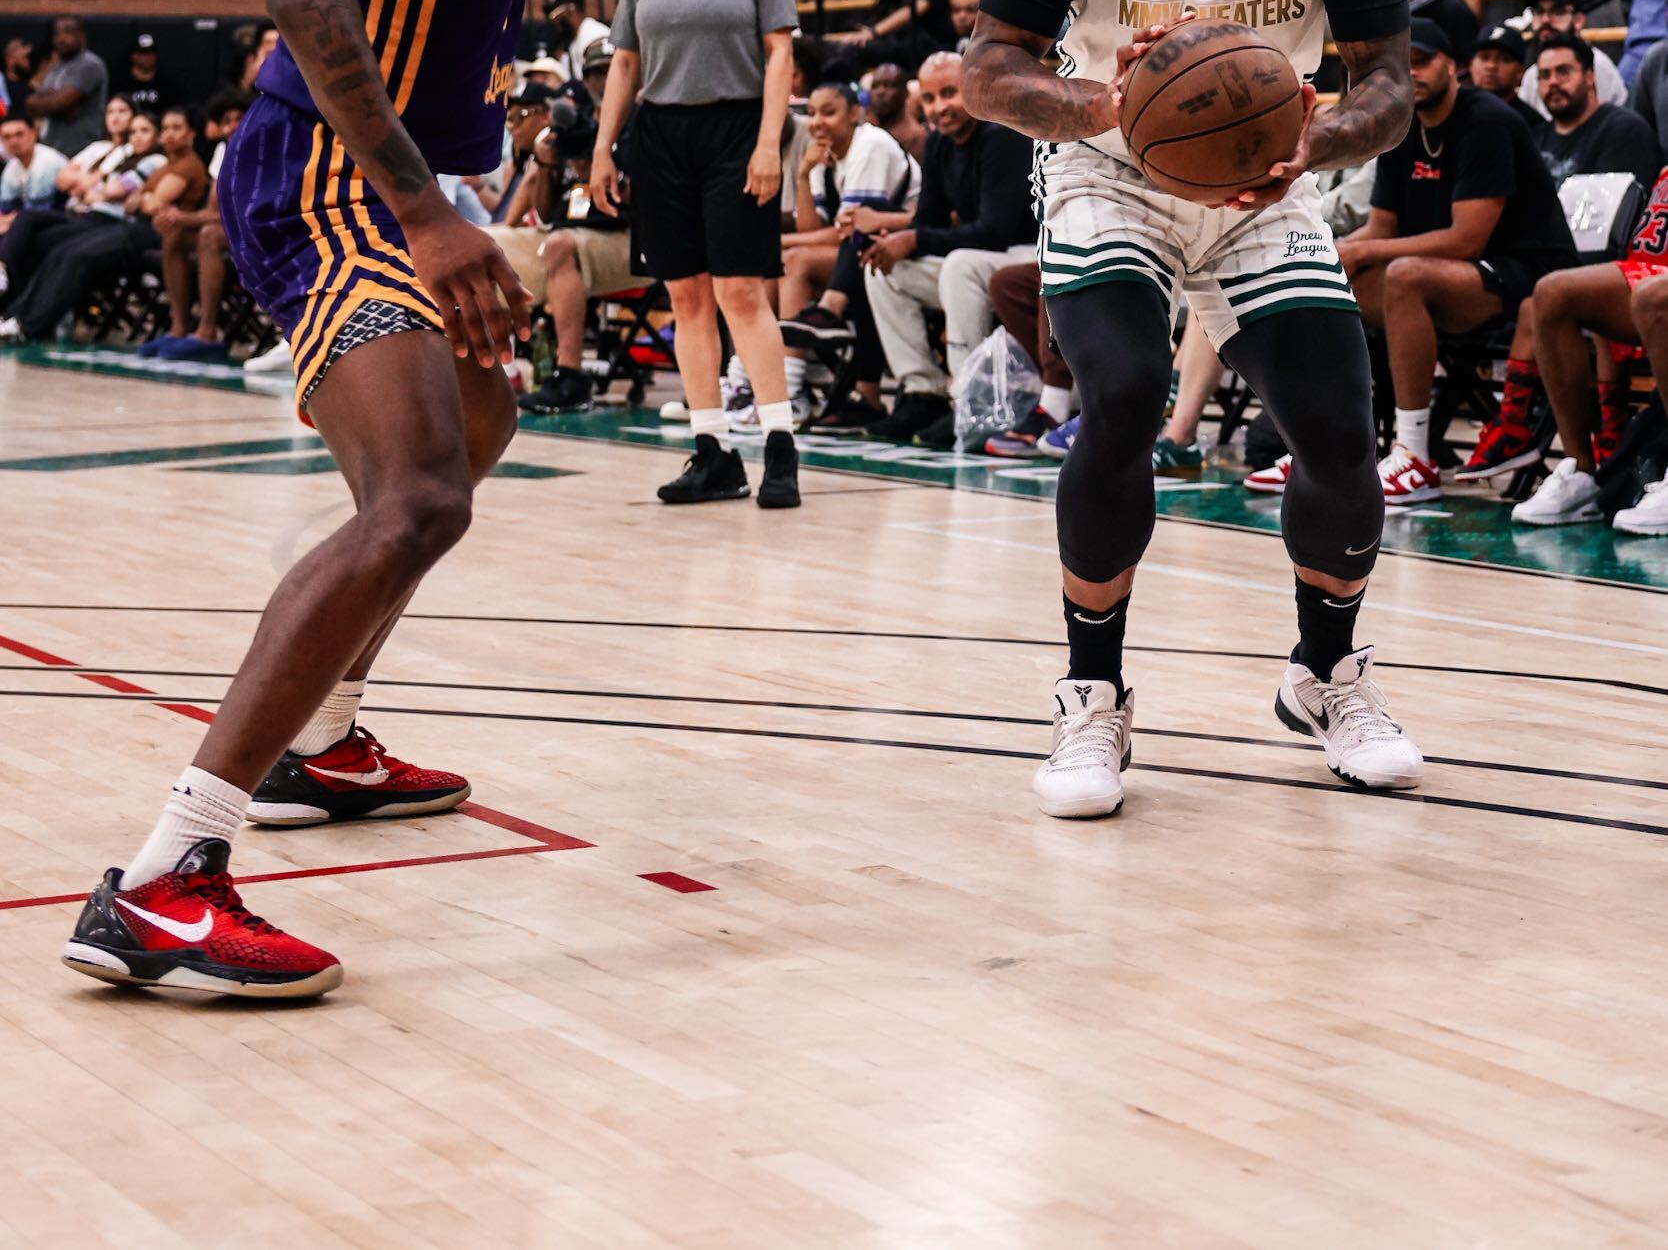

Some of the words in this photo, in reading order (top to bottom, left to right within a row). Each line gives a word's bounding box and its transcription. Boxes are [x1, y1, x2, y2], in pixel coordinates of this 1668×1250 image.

[1286, 231, 1323, 244] Drew
[1632, 210, 1668, 253] 23
[1283, 243, 1330, 258] League
